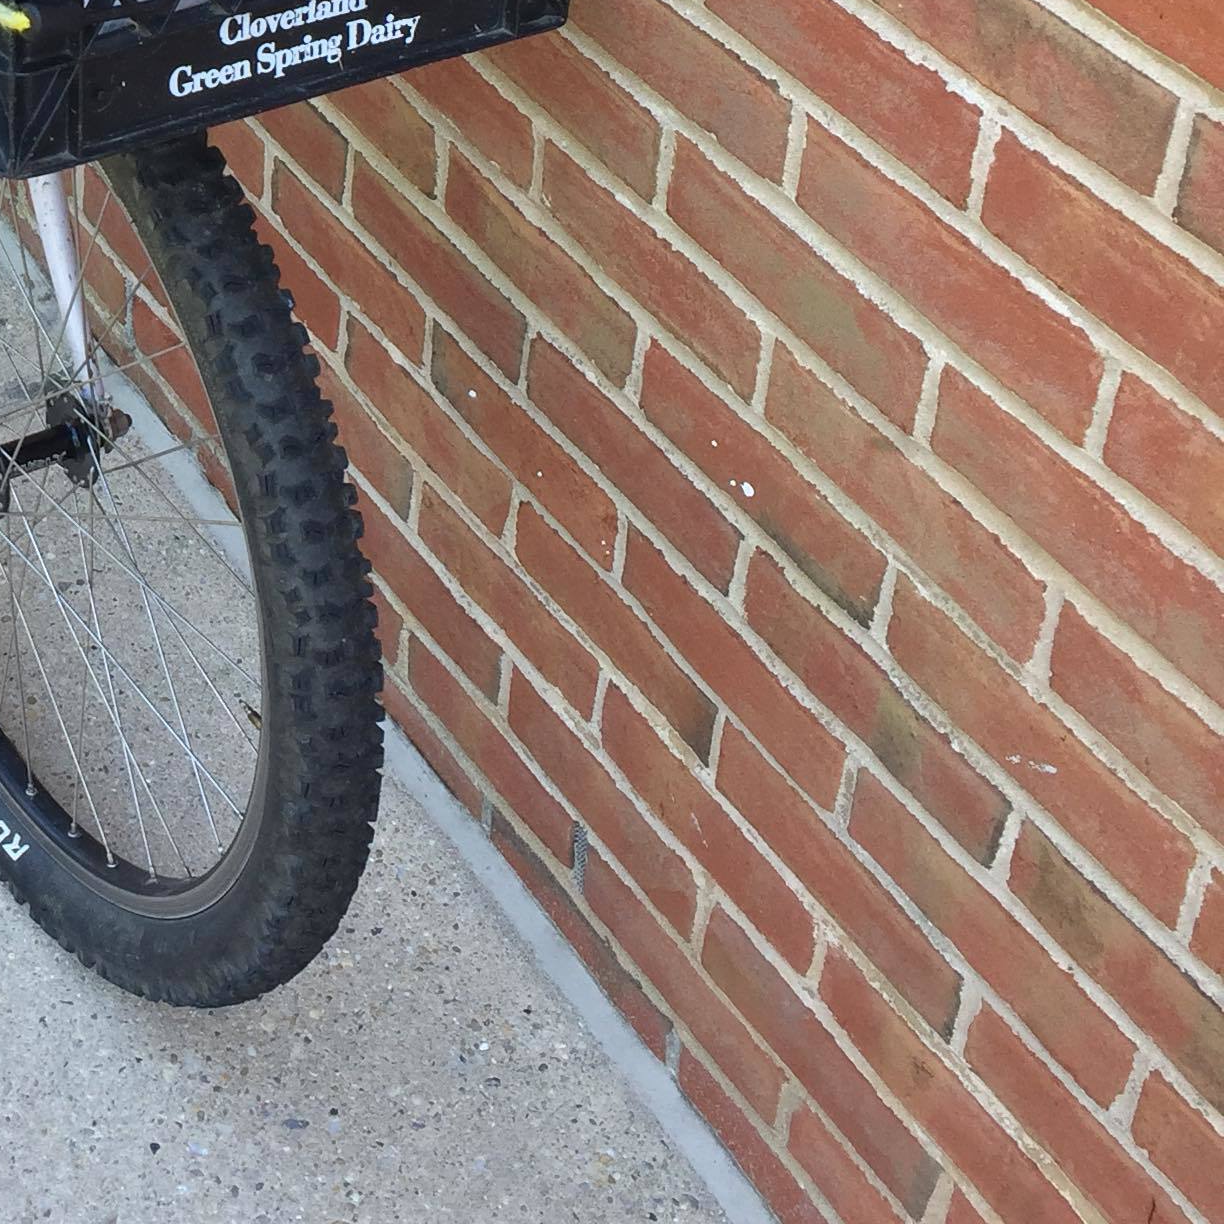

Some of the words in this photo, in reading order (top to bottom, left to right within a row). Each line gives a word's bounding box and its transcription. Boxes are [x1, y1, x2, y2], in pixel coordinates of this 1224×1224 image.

[169, 59, 252, 98] Green
[256, 32, 343, 79] Spring
[346, 13, 422, 51] Dairy
